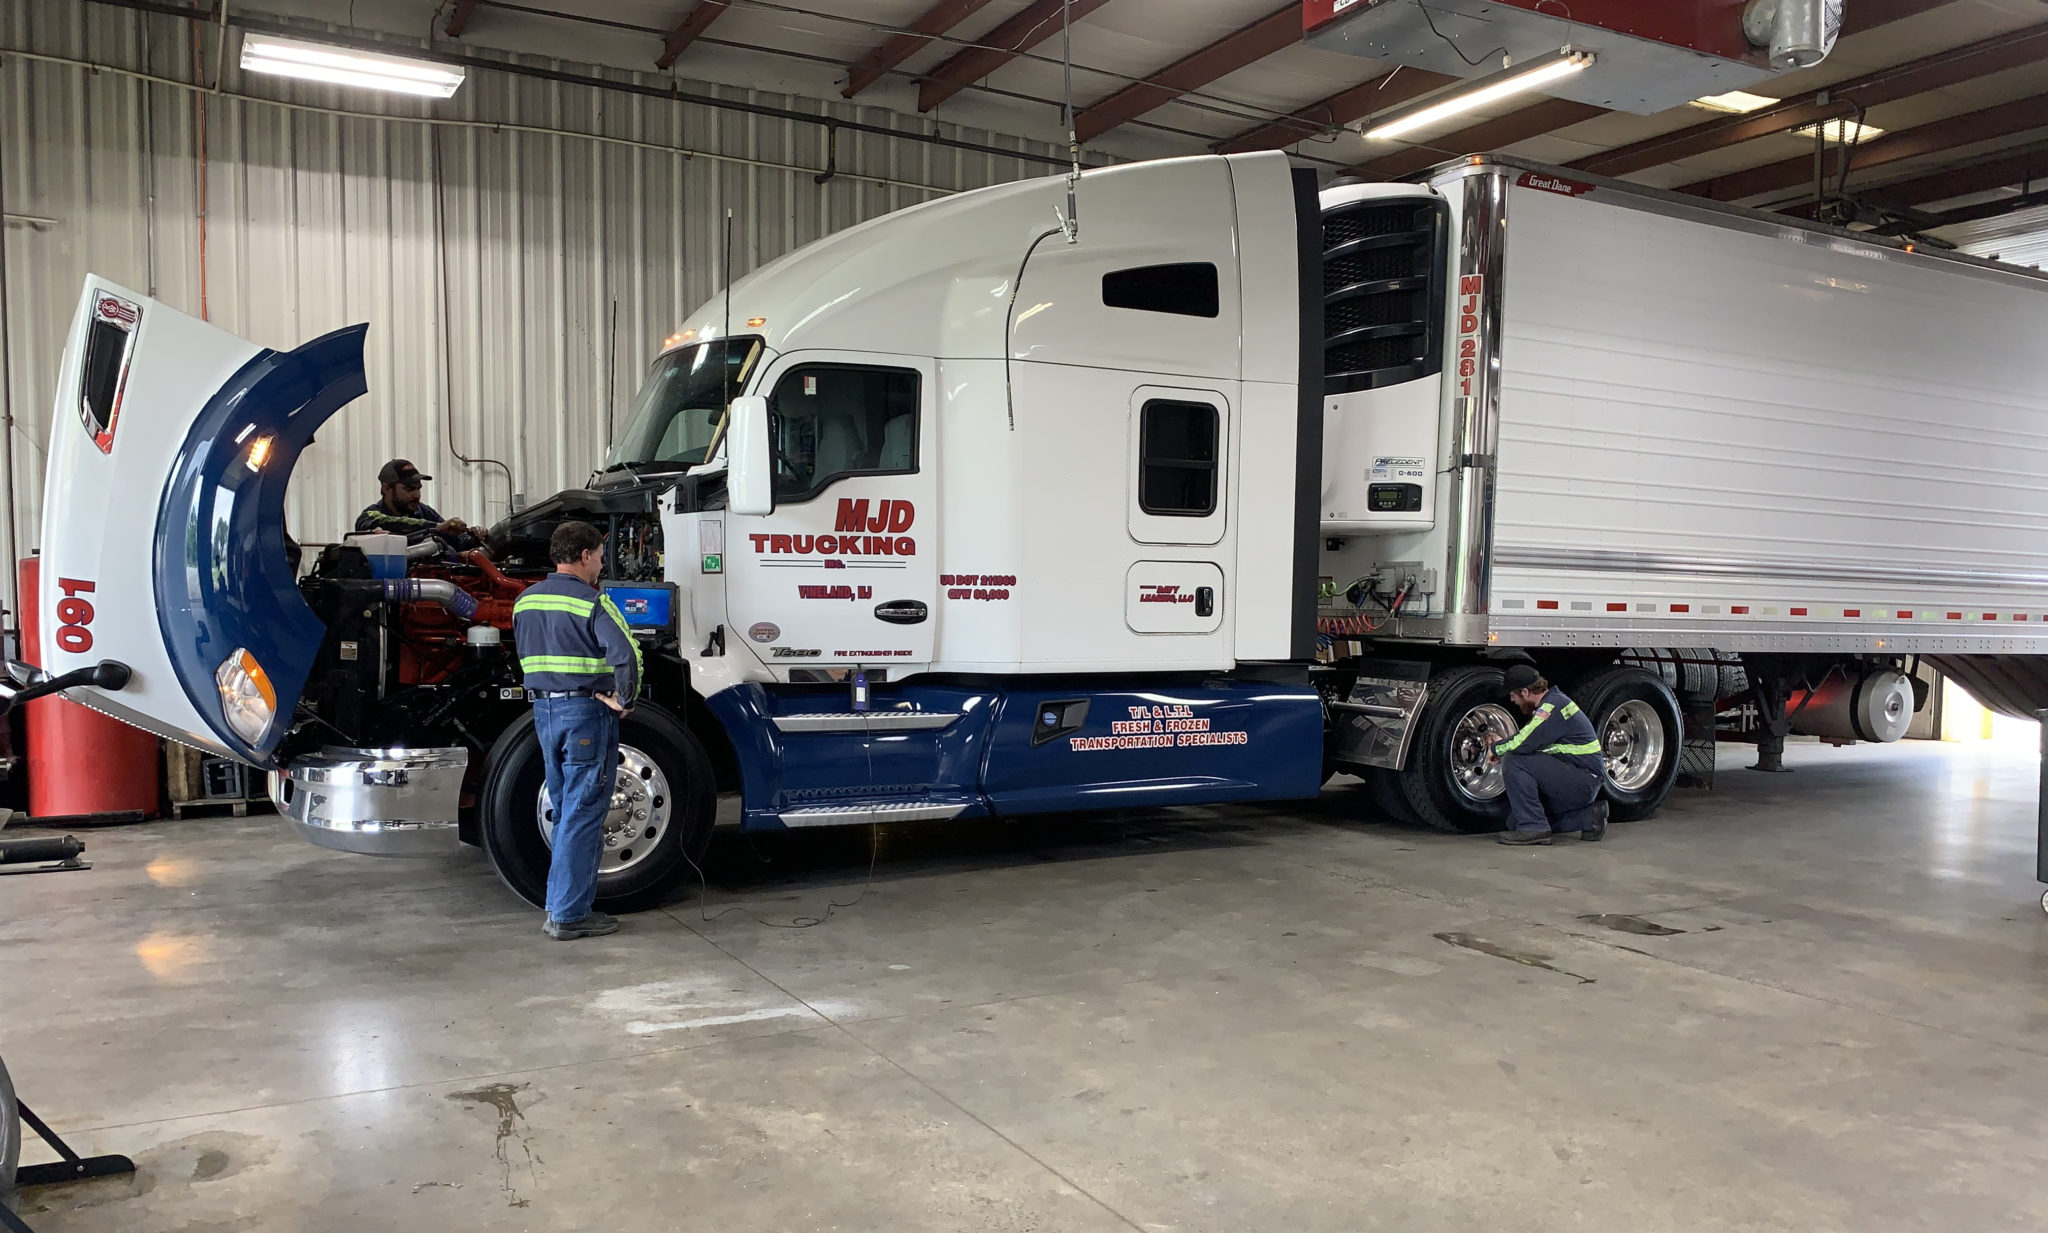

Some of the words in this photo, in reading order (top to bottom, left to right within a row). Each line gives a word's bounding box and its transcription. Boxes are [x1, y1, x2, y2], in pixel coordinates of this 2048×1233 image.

[1529, 174, 1551, 190] Great
[1551, 179, 1572, 193] Dane
[1461, 276, 1481, 333] MJD
[1460, 339, 1475, 395] 281
[835, 498, 915, 533] MJD
[749, 534, 916, 555] TRUCKING
[956, 575, 979, 586] DOT
[798, 585, 855, 601] VINELAND,
[858, 586, 872, 599] NJ
[1129, 706, 1150, 718] T/L
[1153, 706, 1164, 718] &
[1112, 721, 1150, 734] FRESH
[1154, 720, 1163, 732] &
[1165, 719, 1210, 732] FROZEN
[1070, 734, 1174, 751] TRANSPORTATION
[1178, 732, 1247, 746] SPECIALISTS
